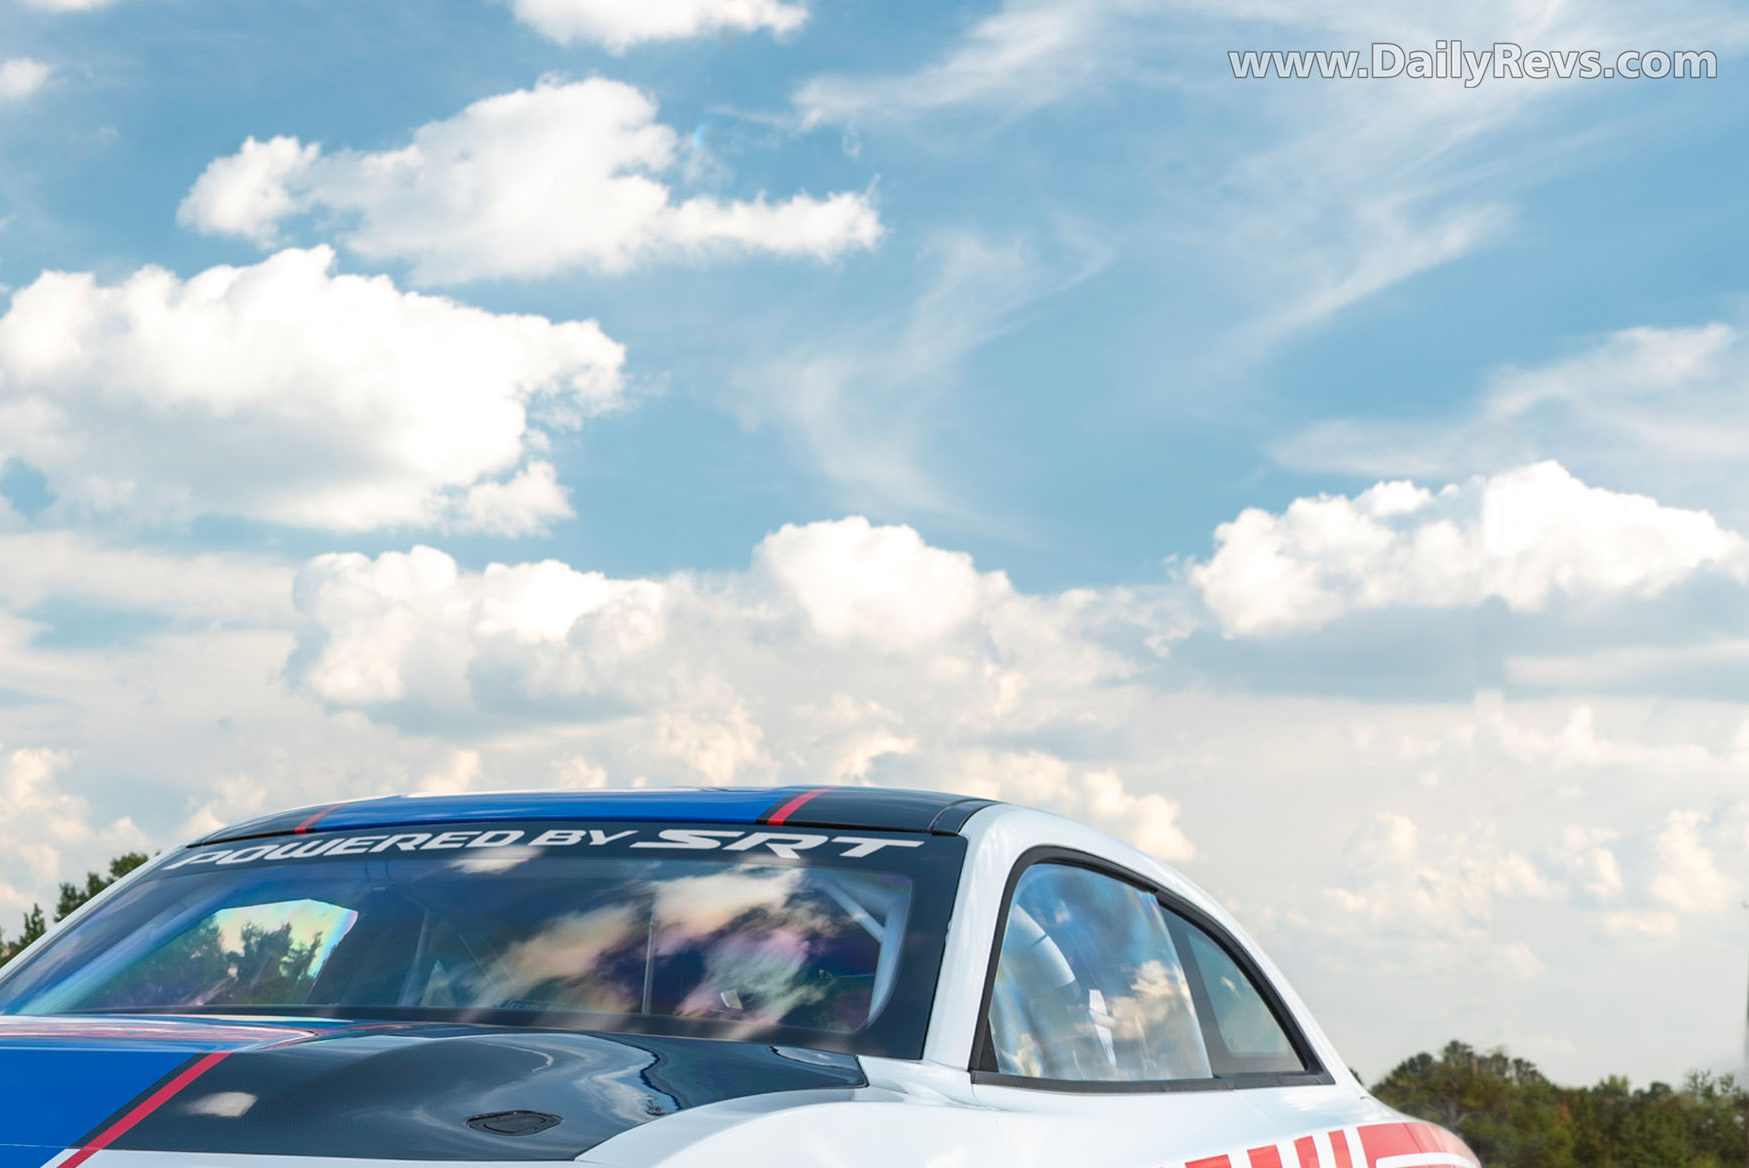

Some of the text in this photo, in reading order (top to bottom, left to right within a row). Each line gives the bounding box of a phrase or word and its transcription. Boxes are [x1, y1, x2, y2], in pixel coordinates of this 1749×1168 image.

[162, 829, 925, 871] POWERED BY SRT
